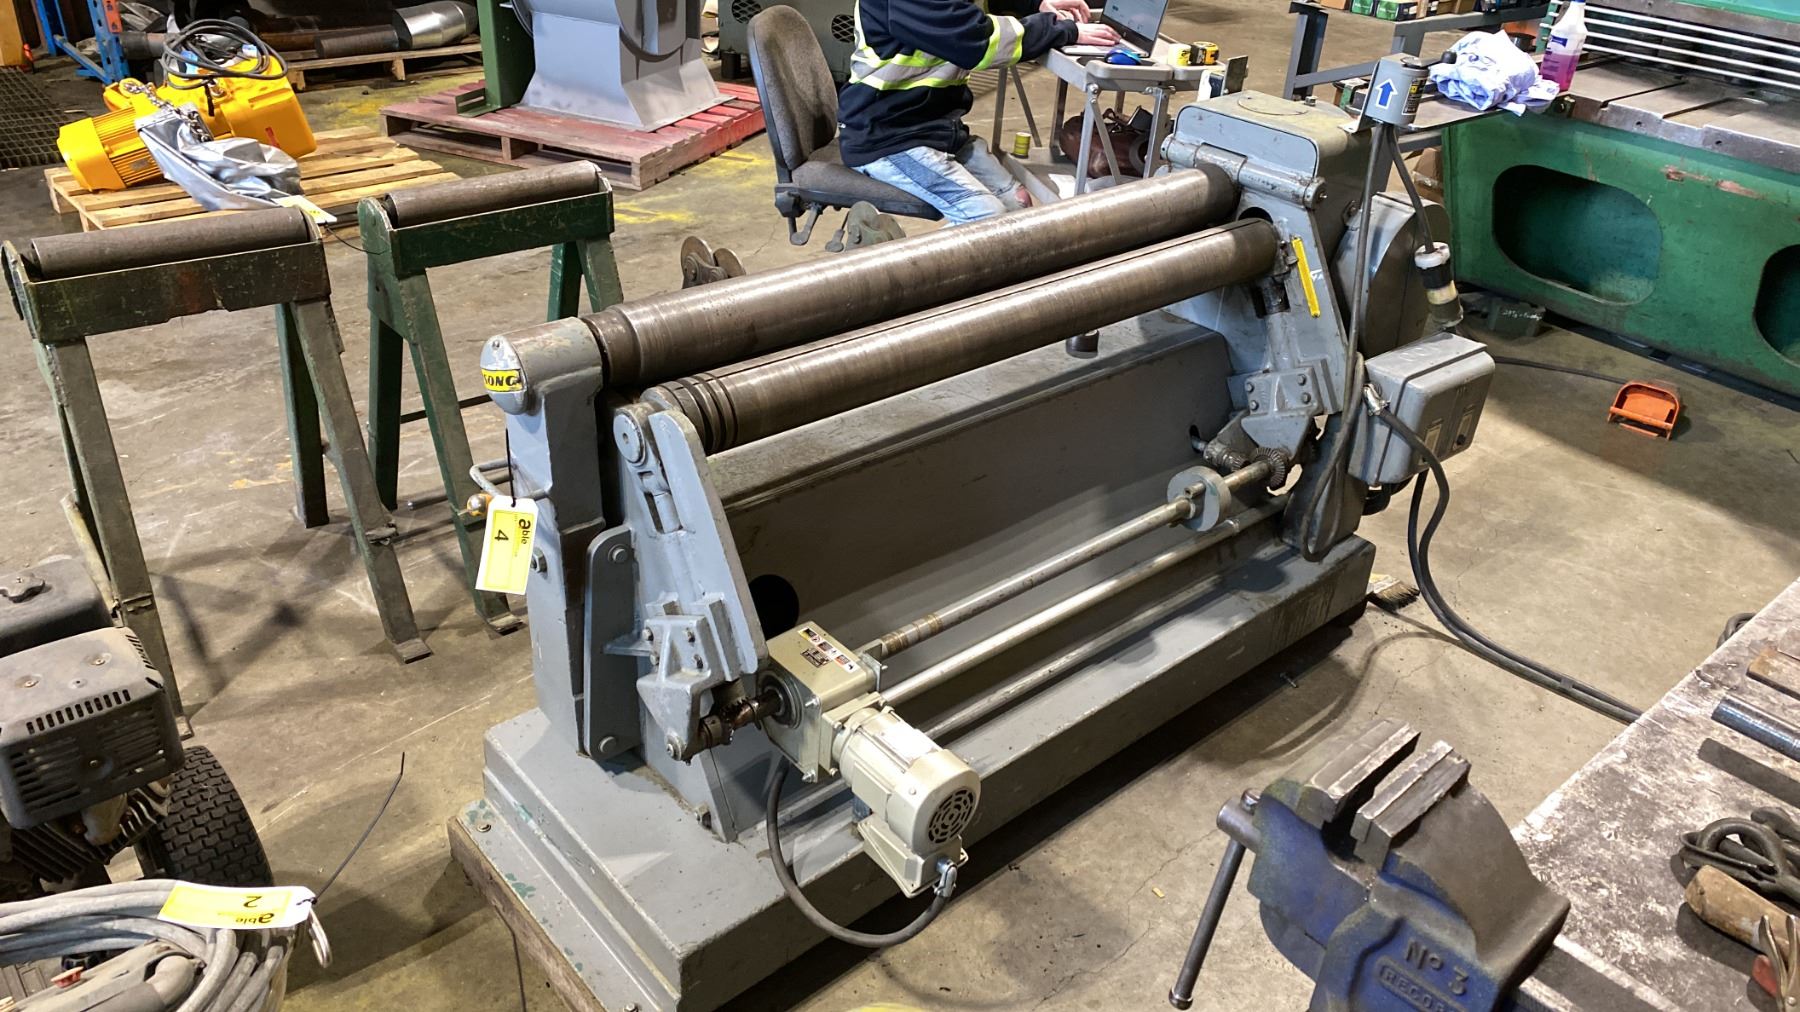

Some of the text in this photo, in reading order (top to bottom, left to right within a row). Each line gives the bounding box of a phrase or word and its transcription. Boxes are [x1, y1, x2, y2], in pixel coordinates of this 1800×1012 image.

[494, 529, 509, 541] 4
[518, 518, 531, 545] able
[243, 895, 262, 908] 2
[235, 912, 275, 924] able
[1448, 965, 1469, 996] 3
